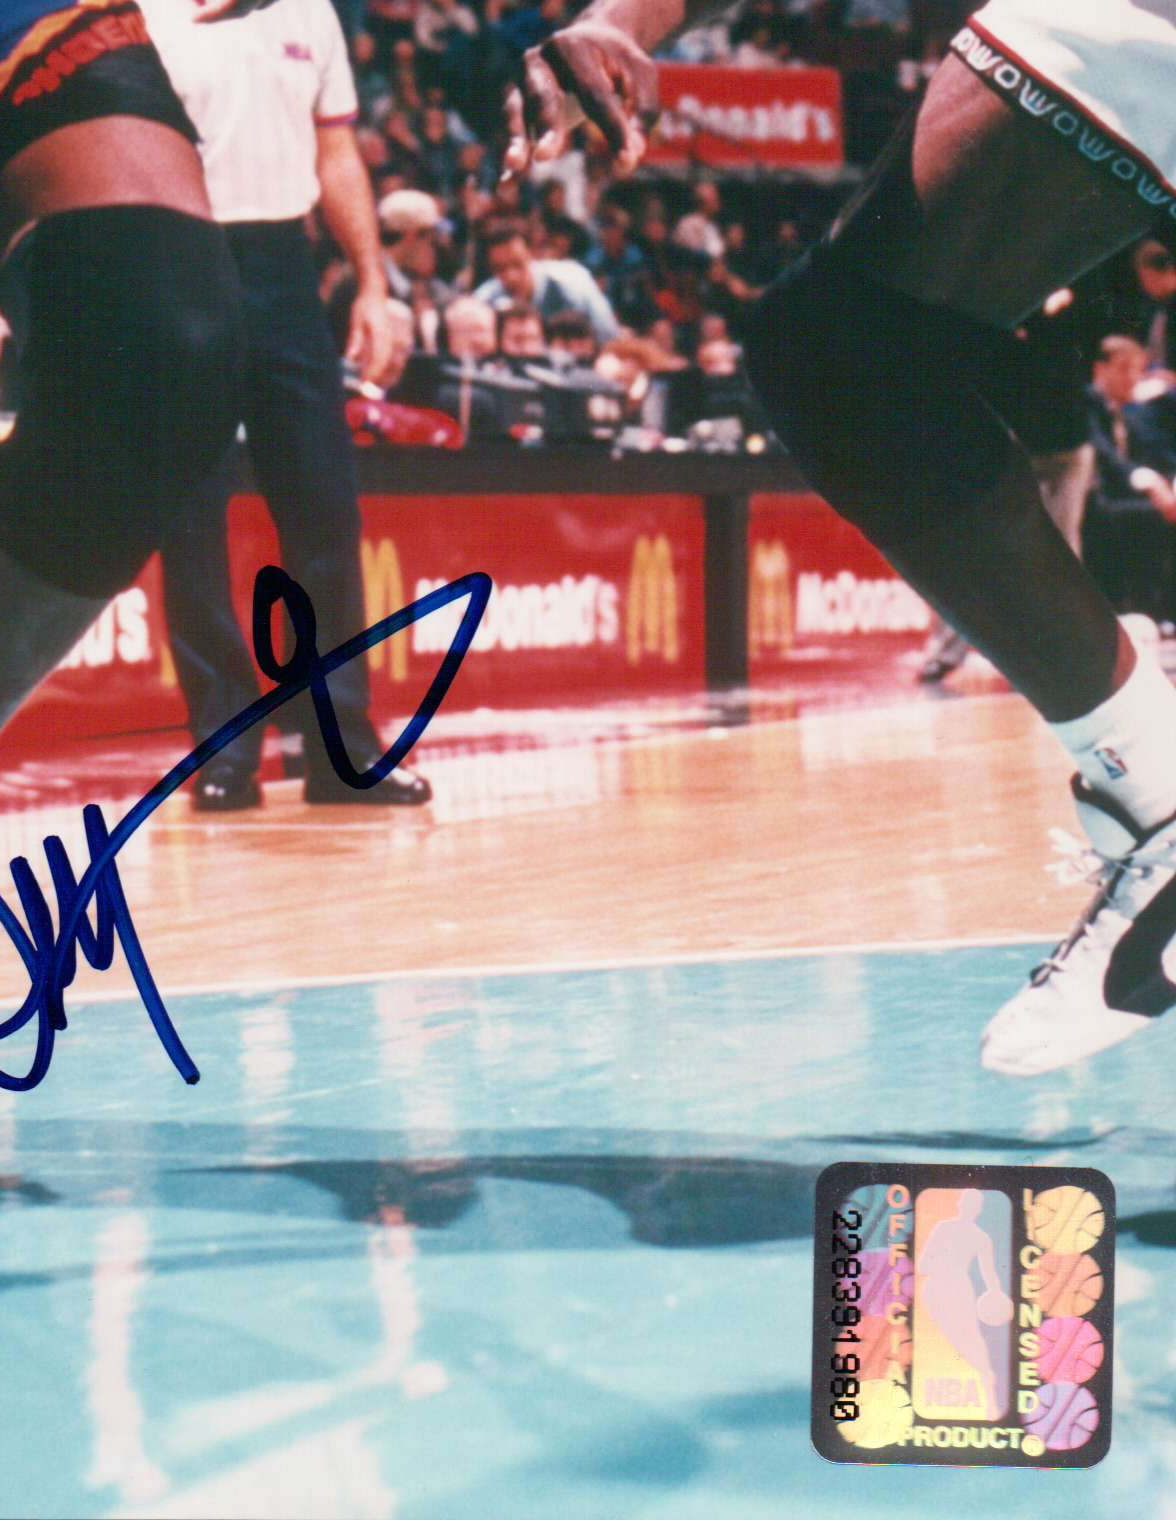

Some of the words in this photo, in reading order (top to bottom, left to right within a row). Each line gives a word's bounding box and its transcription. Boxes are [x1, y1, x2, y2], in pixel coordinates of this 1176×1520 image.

[830, 1209, 862, 1422] 228391980
[886, 1183, 912, 1405] OFFICIA
[898, 1425, 1025, 1448] PRODUCT
